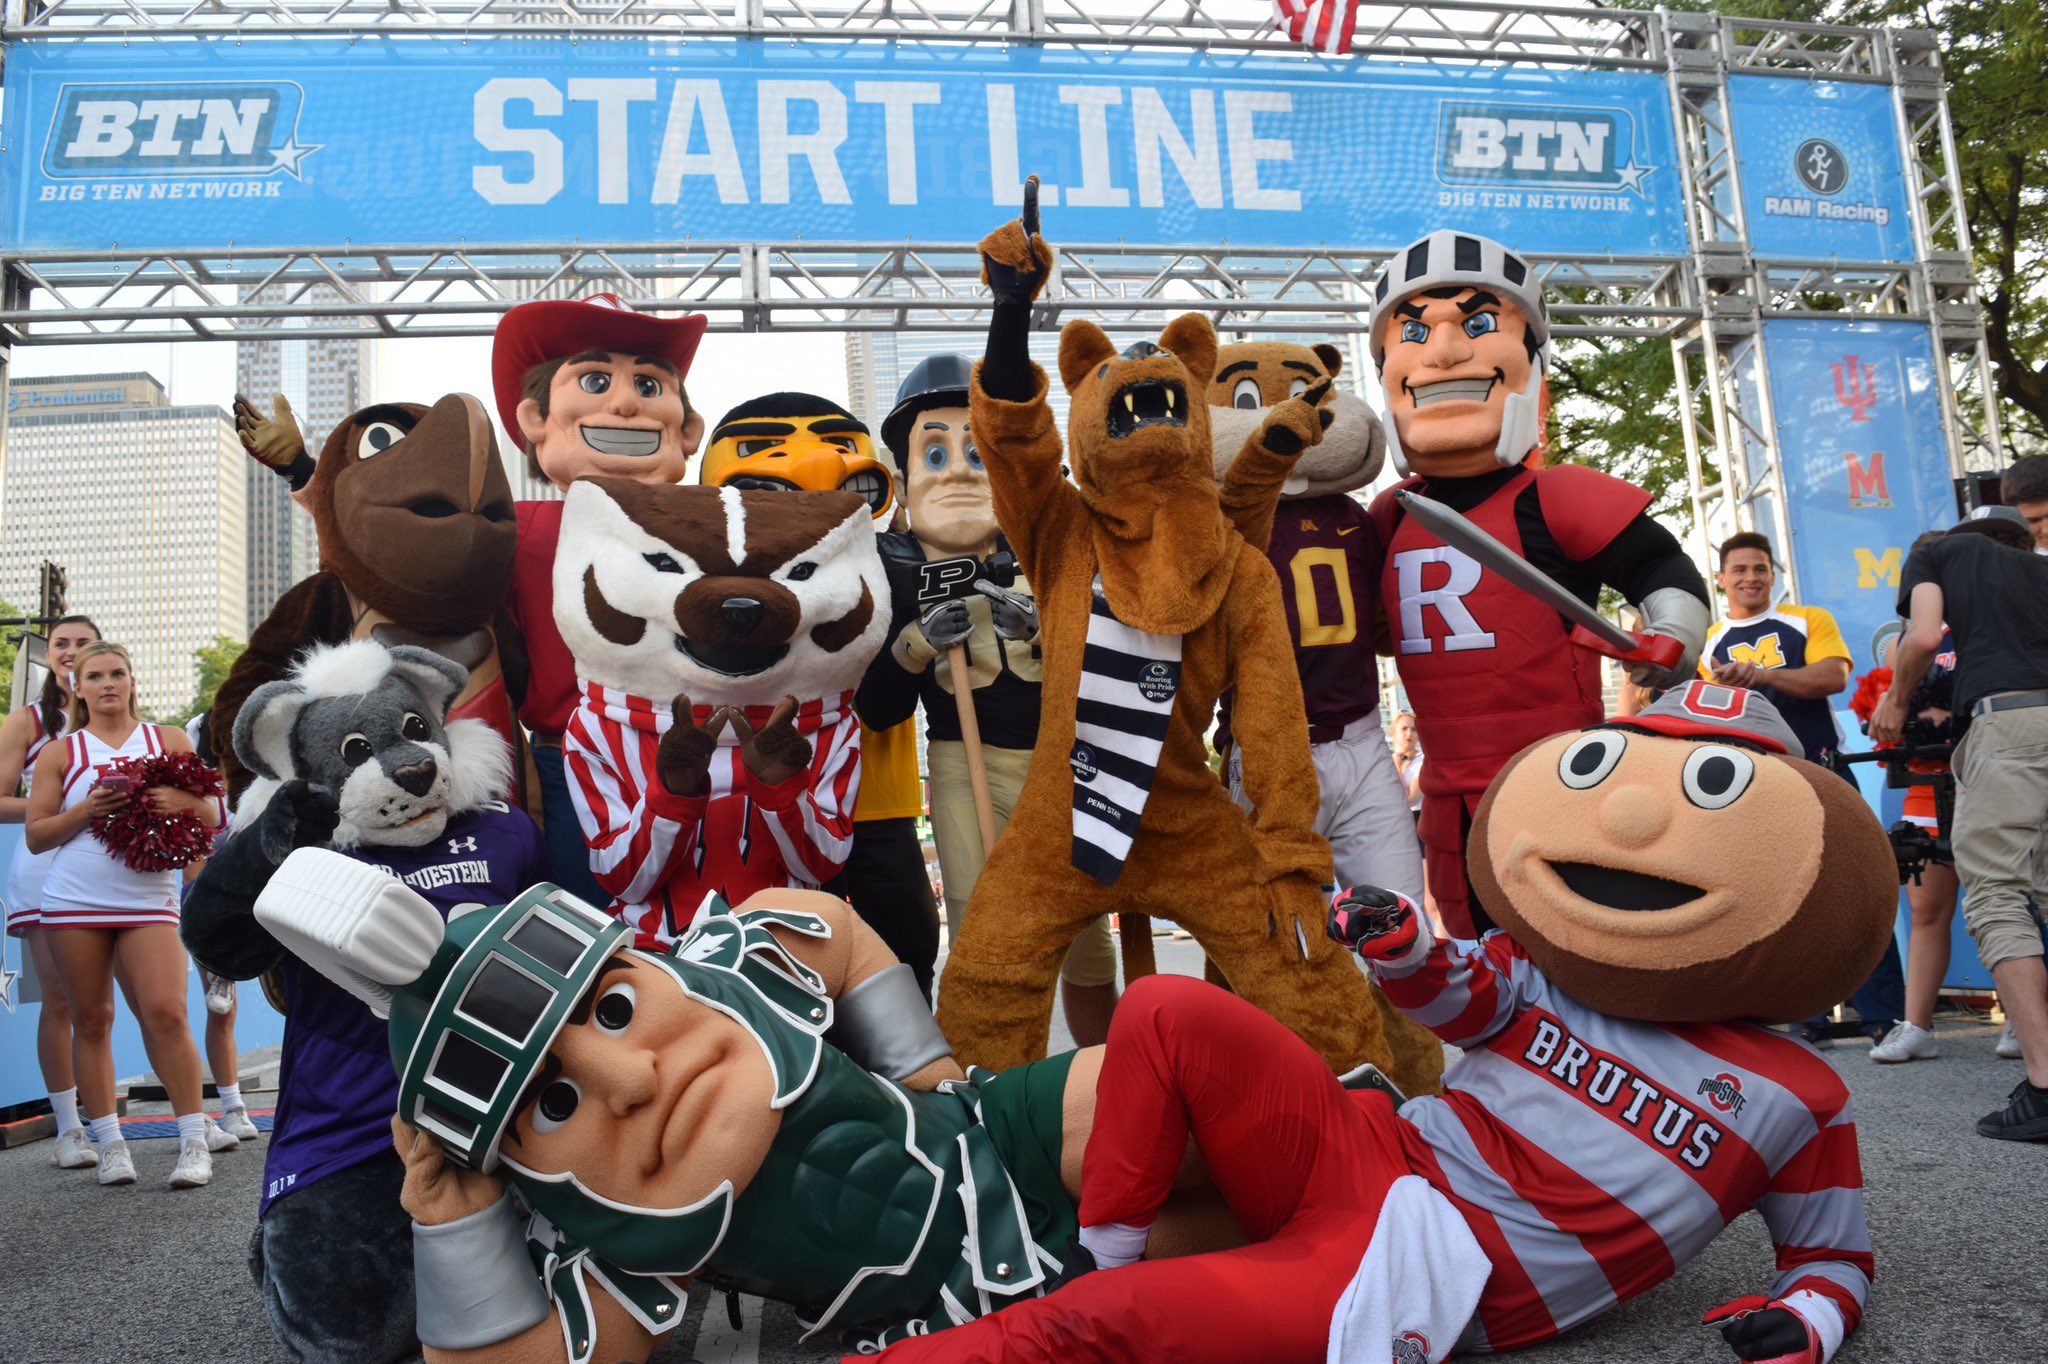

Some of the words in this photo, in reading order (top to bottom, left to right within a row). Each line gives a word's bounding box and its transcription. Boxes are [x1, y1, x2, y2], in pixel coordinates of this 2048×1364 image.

[66, 98, 271, 159] BTN
[472, 77, 942, 206] START
[985, 83, 1302, 211] LINE
[1451, 115, 1610, 174] BTN
[40, 185, 86, 201] BIG
[91, 183, 144, 200] TEN
[149, 181, 284, 199] NETWORK
[1438, 191, 1477, 207] BIG
[1479, 192, 1522, 208] TEN
[1526, 194, 1632, 212] NETWORK
[1764, 196, 1812, 217] RAM
[1816, 200, 1889, 227] Racing
[27, 384, 125, 408] Prudential
[1842, 451, 1891, 500] M
[918, 558, 976, 601] P
[1853, 547, 1902, 589] M
[1393, 544, 1497, 656] R
[1727, 632, 1787, 670] M
[1139, 682, 1156, 690] With
[1157, 682, 1176, 691] Pride
[1145, 675, 1172, 684] Roaring
[1087, 797, 1107, 812] PENN
[1523, 1016, 1724, 1170] BRUTUS
